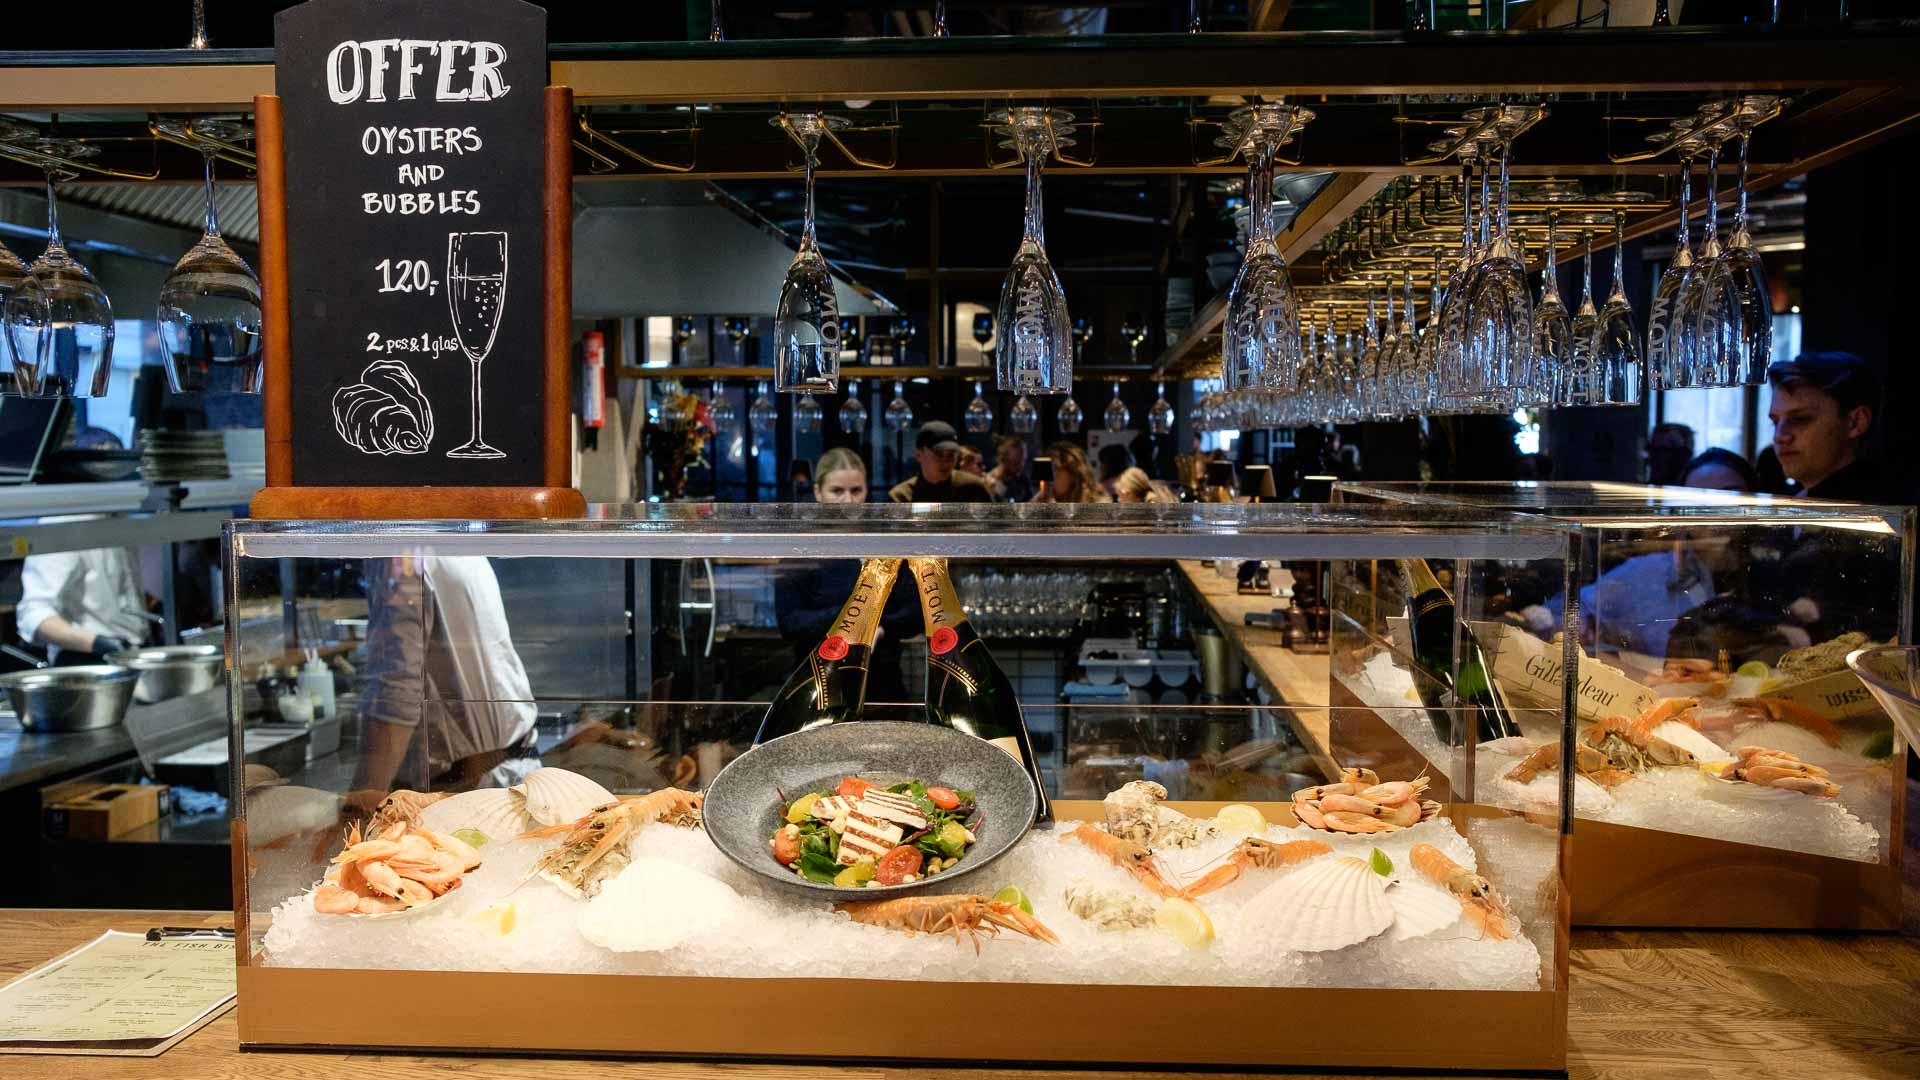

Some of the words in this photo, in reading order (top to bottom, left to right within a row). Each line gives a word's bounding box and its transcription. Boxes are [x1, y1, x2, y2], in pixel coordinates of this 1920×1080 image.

[326, 38, 511, 104] OFFER
[362, 126, 482, 155] OYSTERS
[398, 163, 444, 187] AND
[362, 190, 480, 215] BUBBLES
[366, 332, 384, 352] 2
[1525, 655, 1617, 706] Gilladeau
